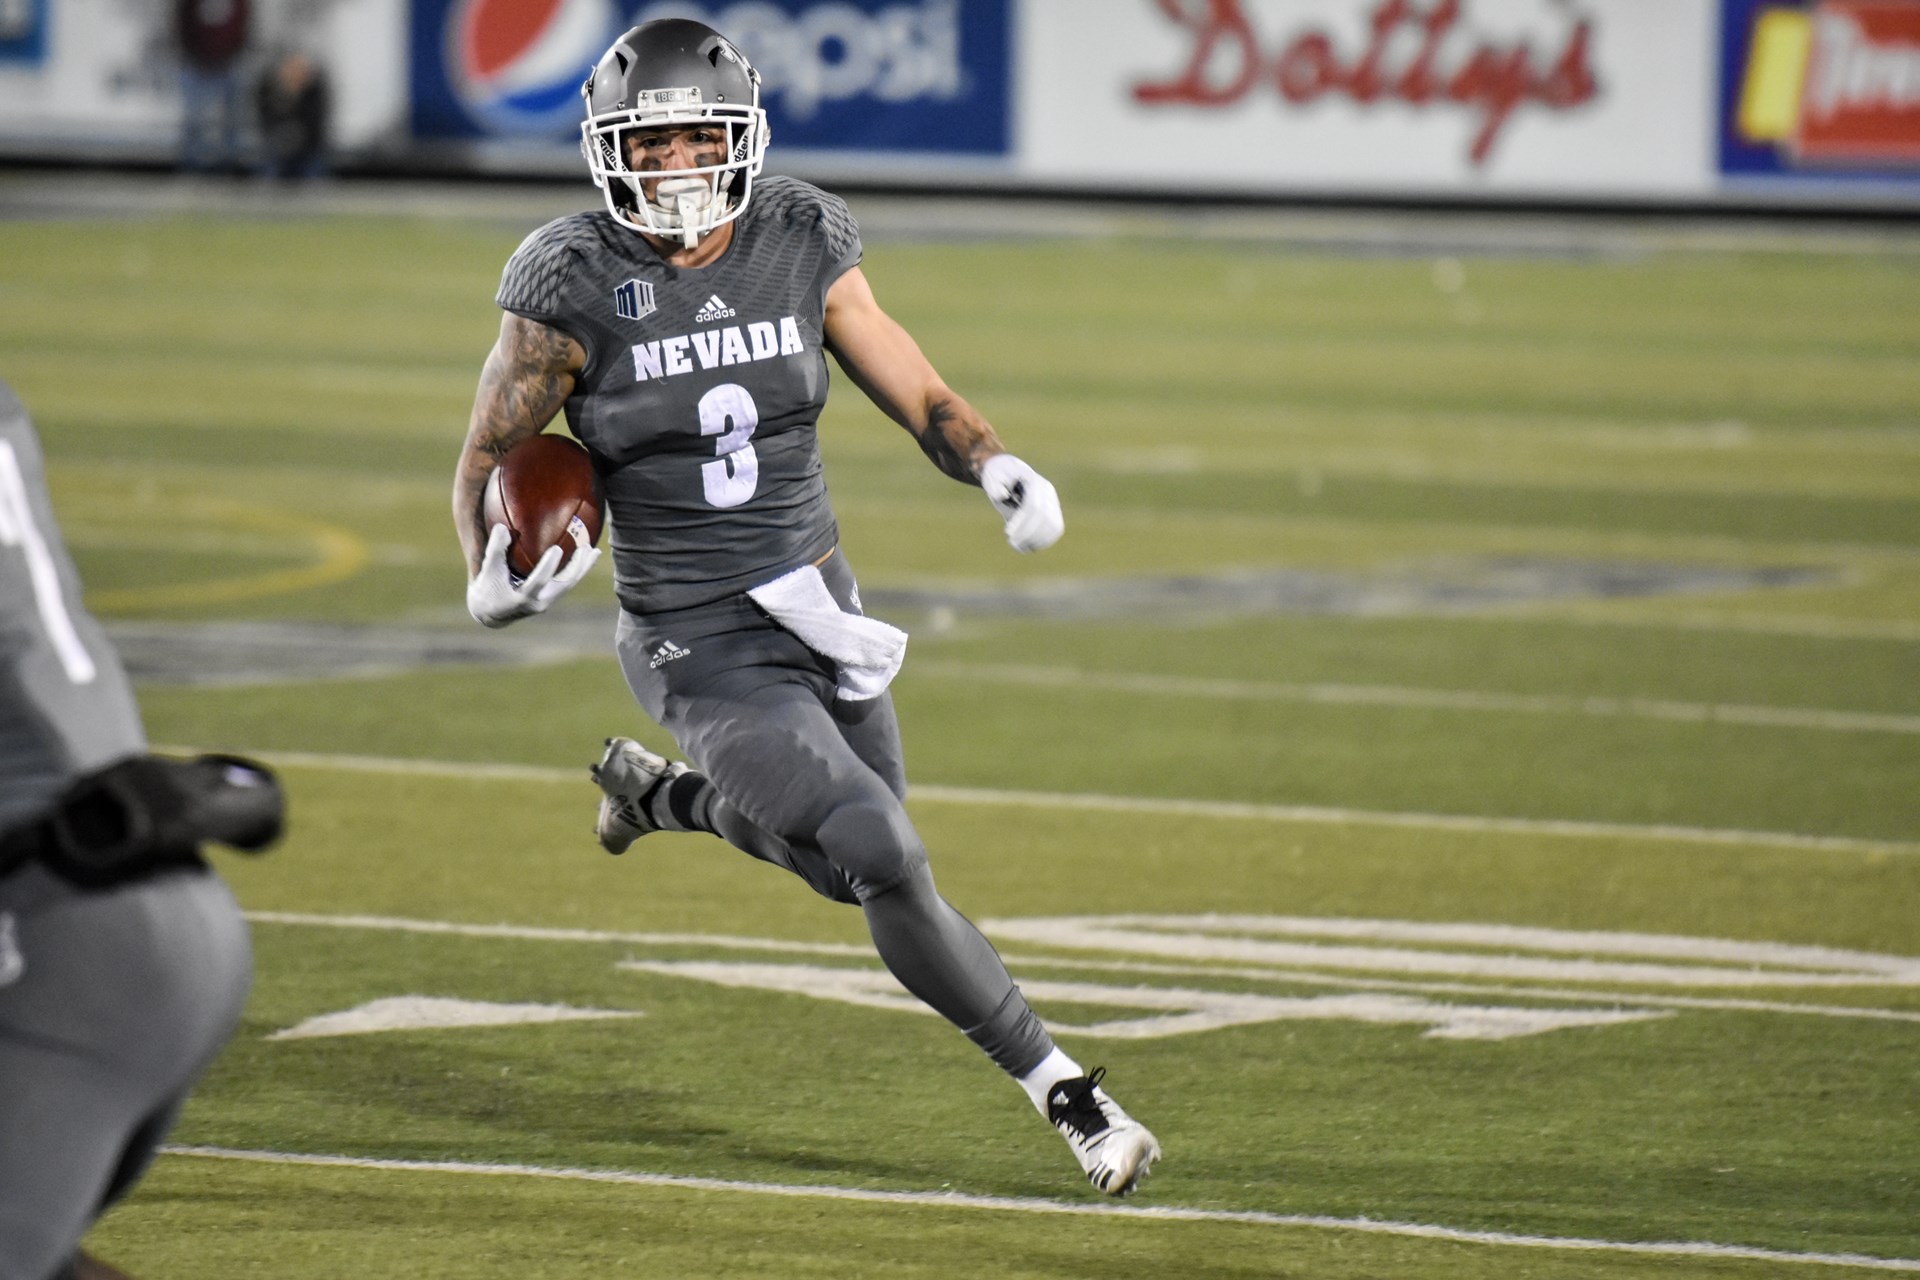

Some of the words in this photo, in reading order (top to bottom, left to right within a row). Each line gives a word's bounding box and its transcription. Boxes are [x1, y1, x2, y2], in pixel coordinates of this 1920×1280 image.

[656, 91, 685, 103] 186
[695, 307, 737, 323] adidas
[631, 316, 804, 382] NEVADA
[698, 383, 759, 508] 3
[650, 648, 691, 669] adidas
